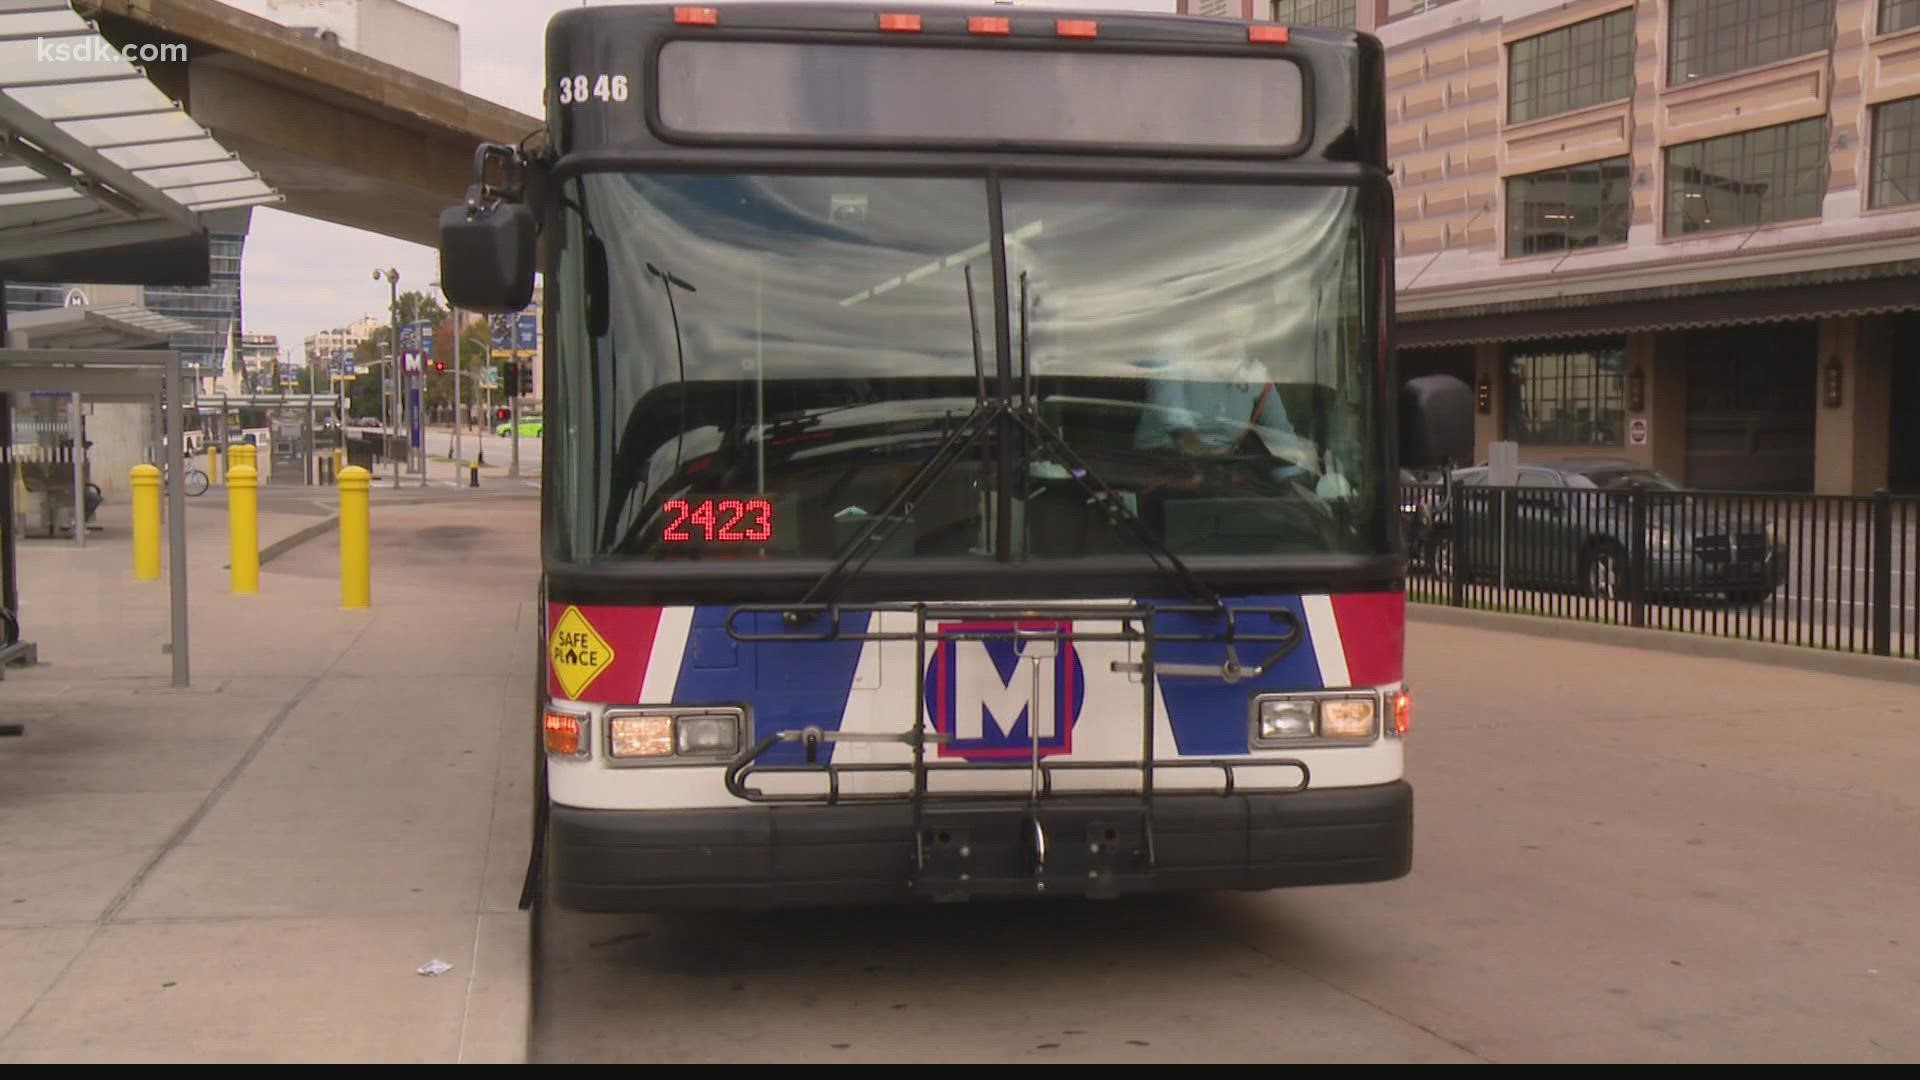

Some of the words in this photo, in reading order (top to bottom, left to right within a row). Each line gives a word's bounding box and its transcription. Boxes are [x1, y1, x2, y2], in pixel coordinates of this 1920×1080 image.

[405, 352, 423, 371] M
[663, 499, 772, 541] 2423
[558, 631, 588, 648] SAFE
[954, 633, 1056, 740] M
